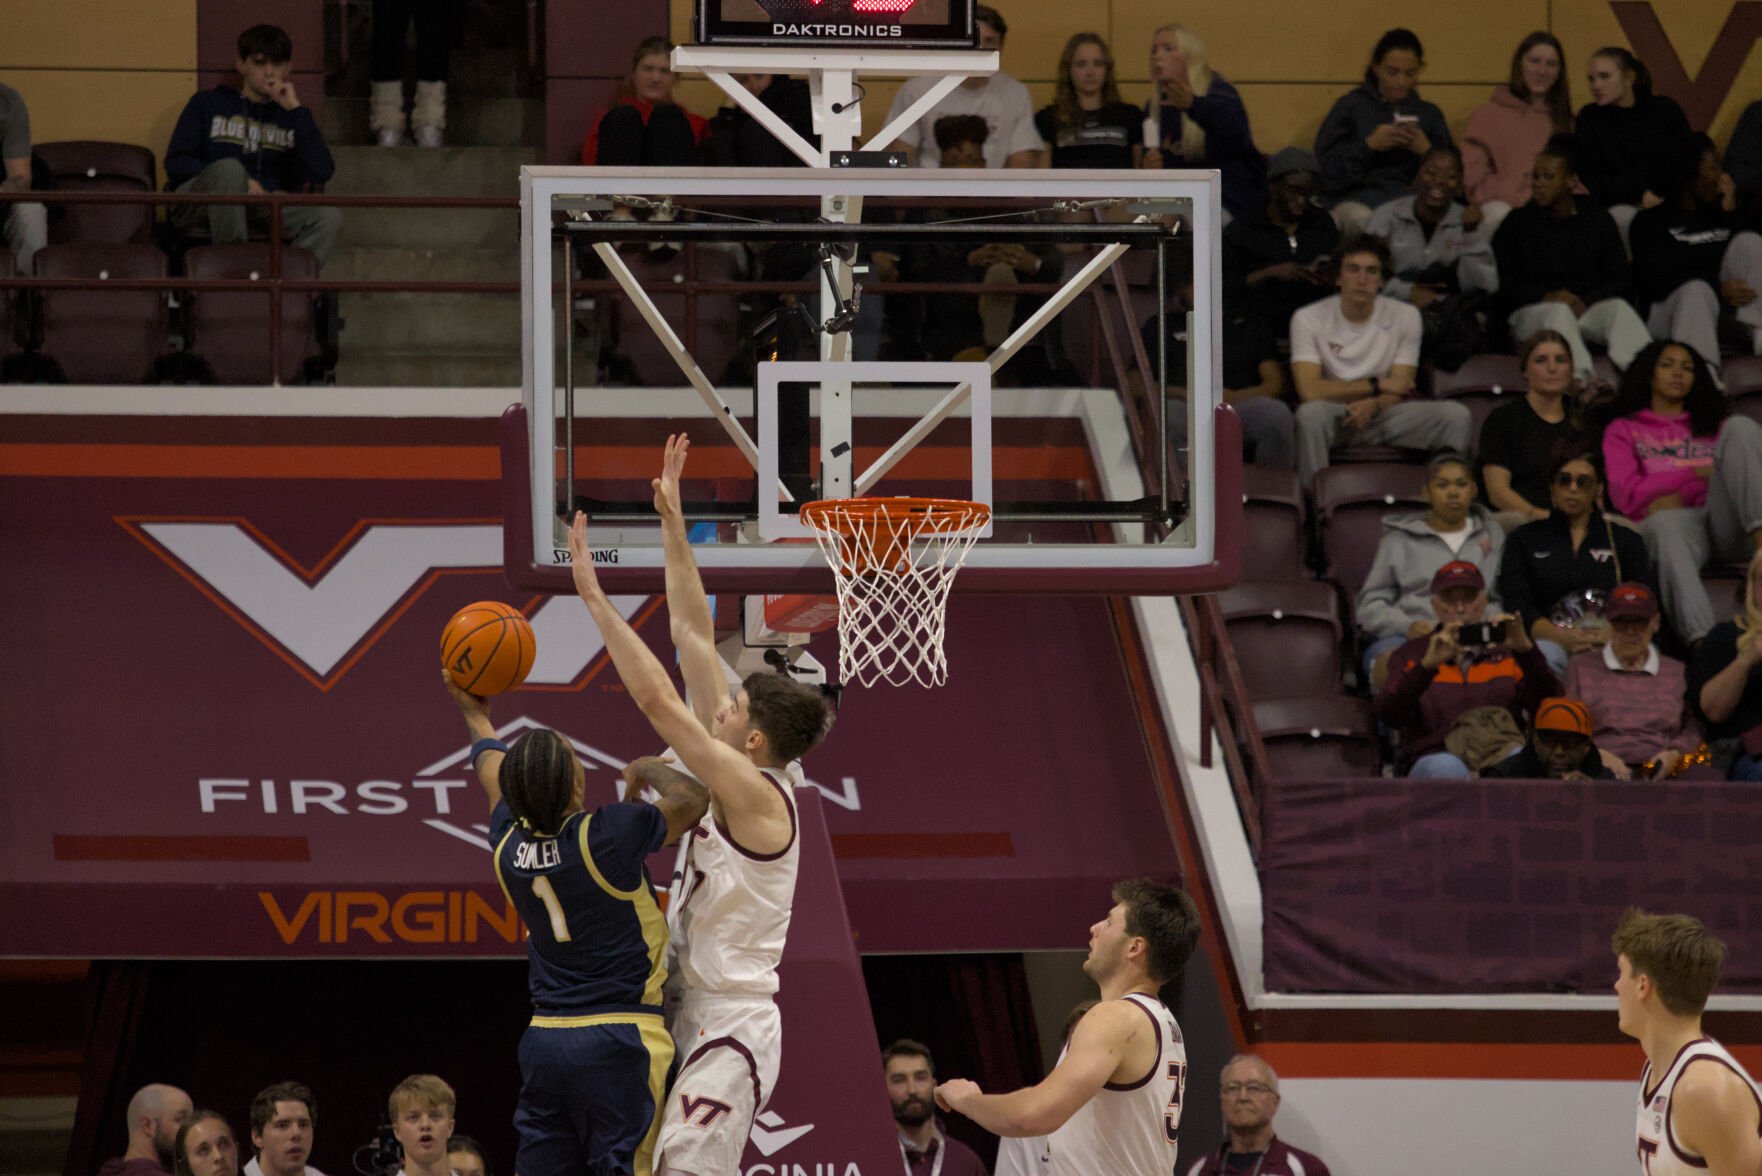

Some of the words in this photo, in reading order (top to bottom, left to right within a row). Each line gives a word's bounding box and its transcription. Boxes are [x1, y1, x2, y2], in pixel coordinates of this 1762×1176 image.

[772, 23, 903, 37] DAKTRONICS
[210, 115, 246, 140] BLUE
[552, 548, 619, 565] SPDING
[198, 778, 468, 816] FIRST
[258, 890, 530, 944] VIRGIN
[531, 875, 573, 943] 1
[678, 1092, 734, 1129] VT
